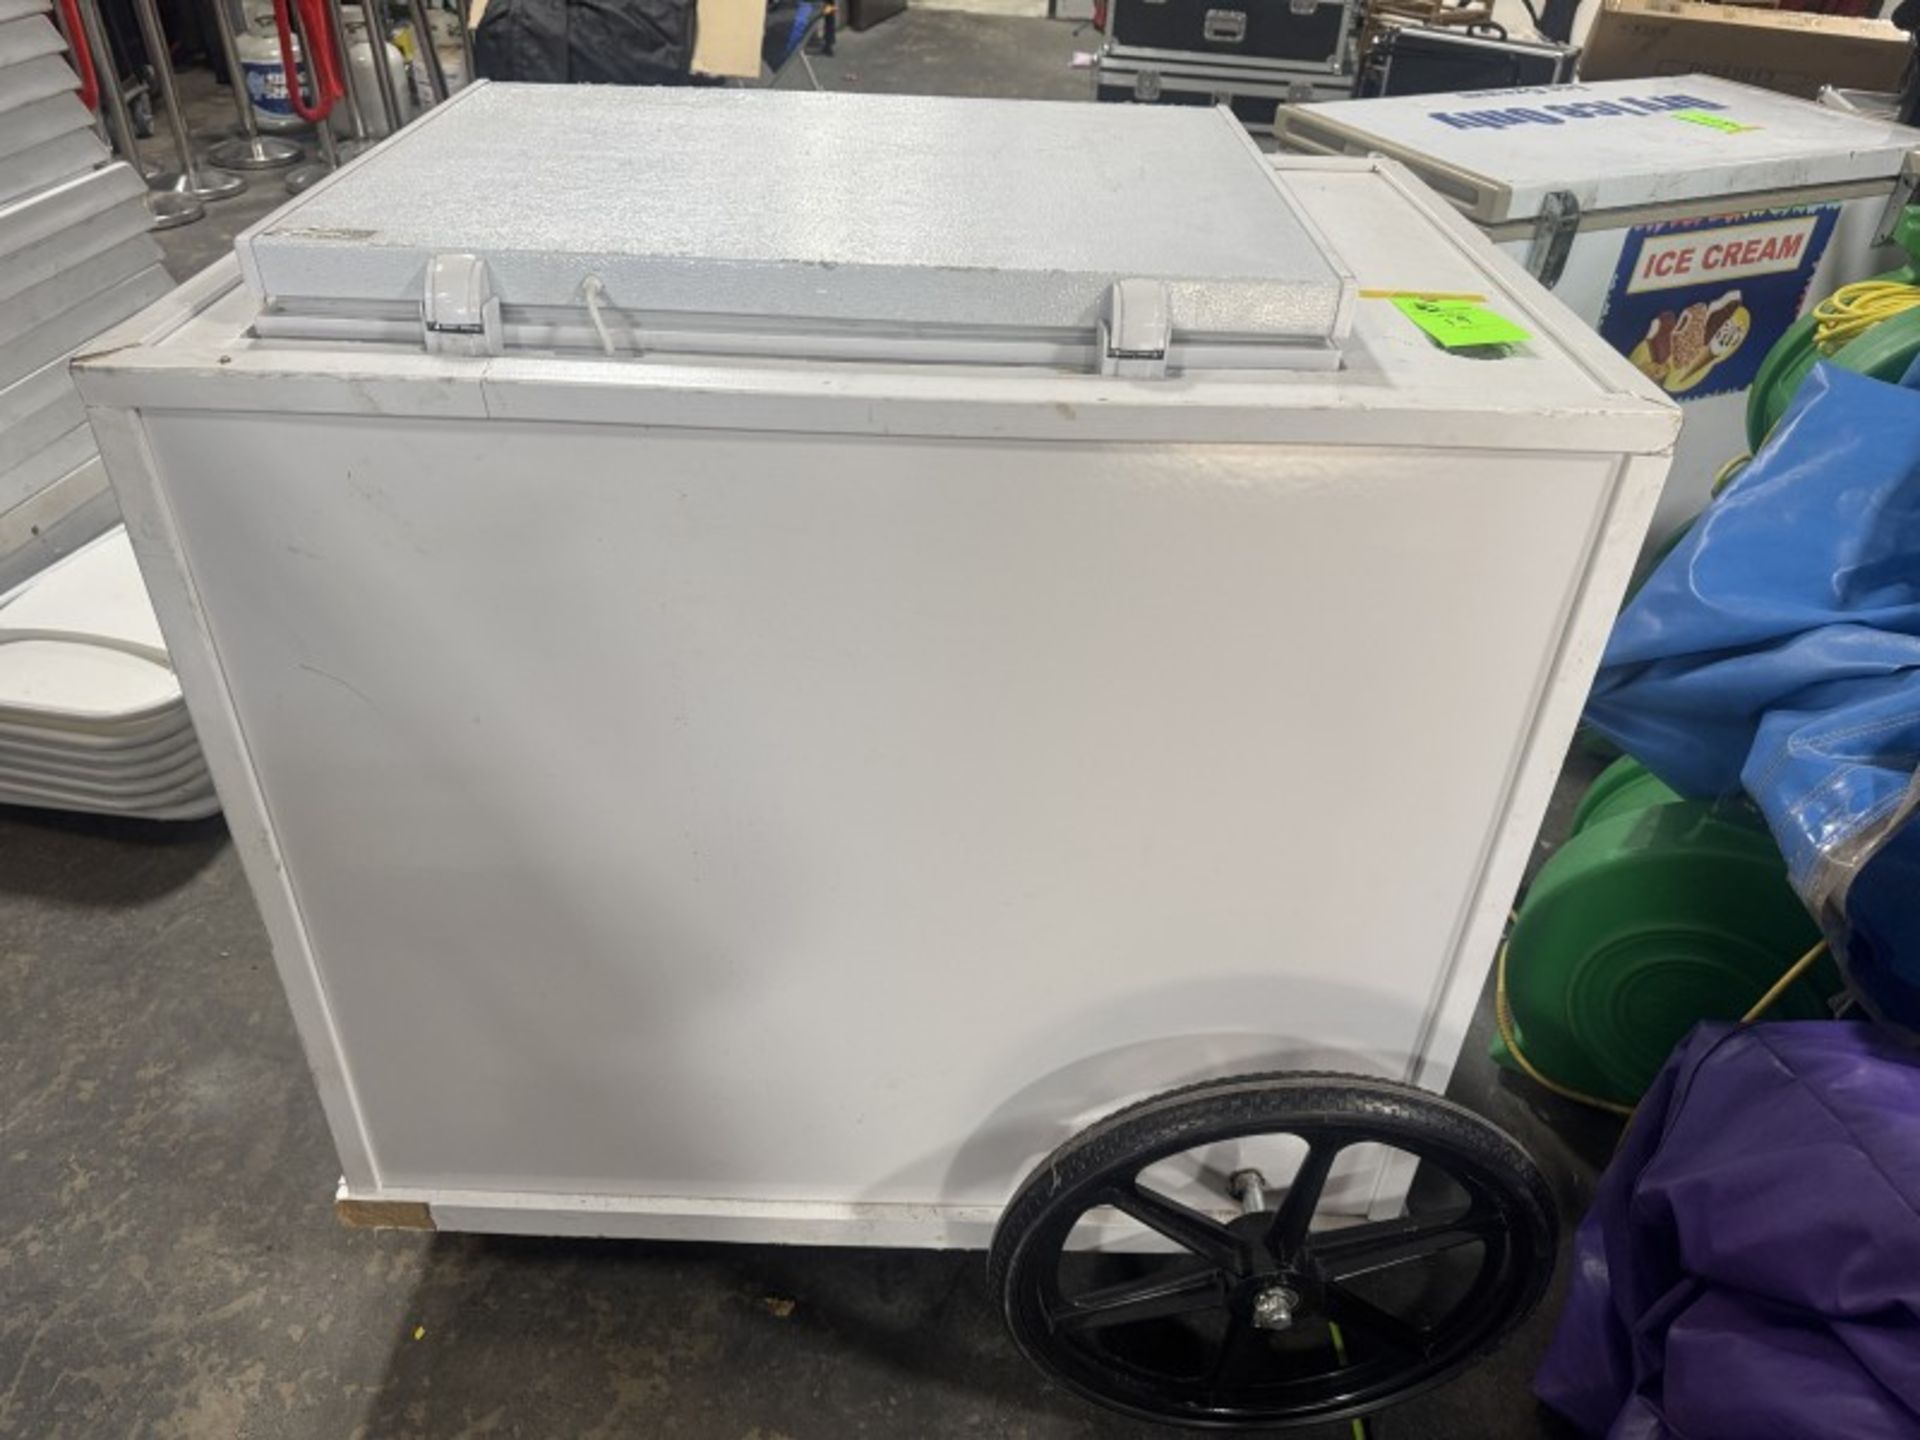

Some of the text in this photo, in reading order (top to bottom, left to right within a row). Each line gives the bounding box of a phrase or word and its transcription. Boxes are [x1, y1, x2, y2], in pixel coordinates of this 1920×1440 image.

[1428, 107, 1566, 130] Only
[1543, 100, 1649, 118] Ice
[1643, 233, 1805, 278] ICE CREAM
